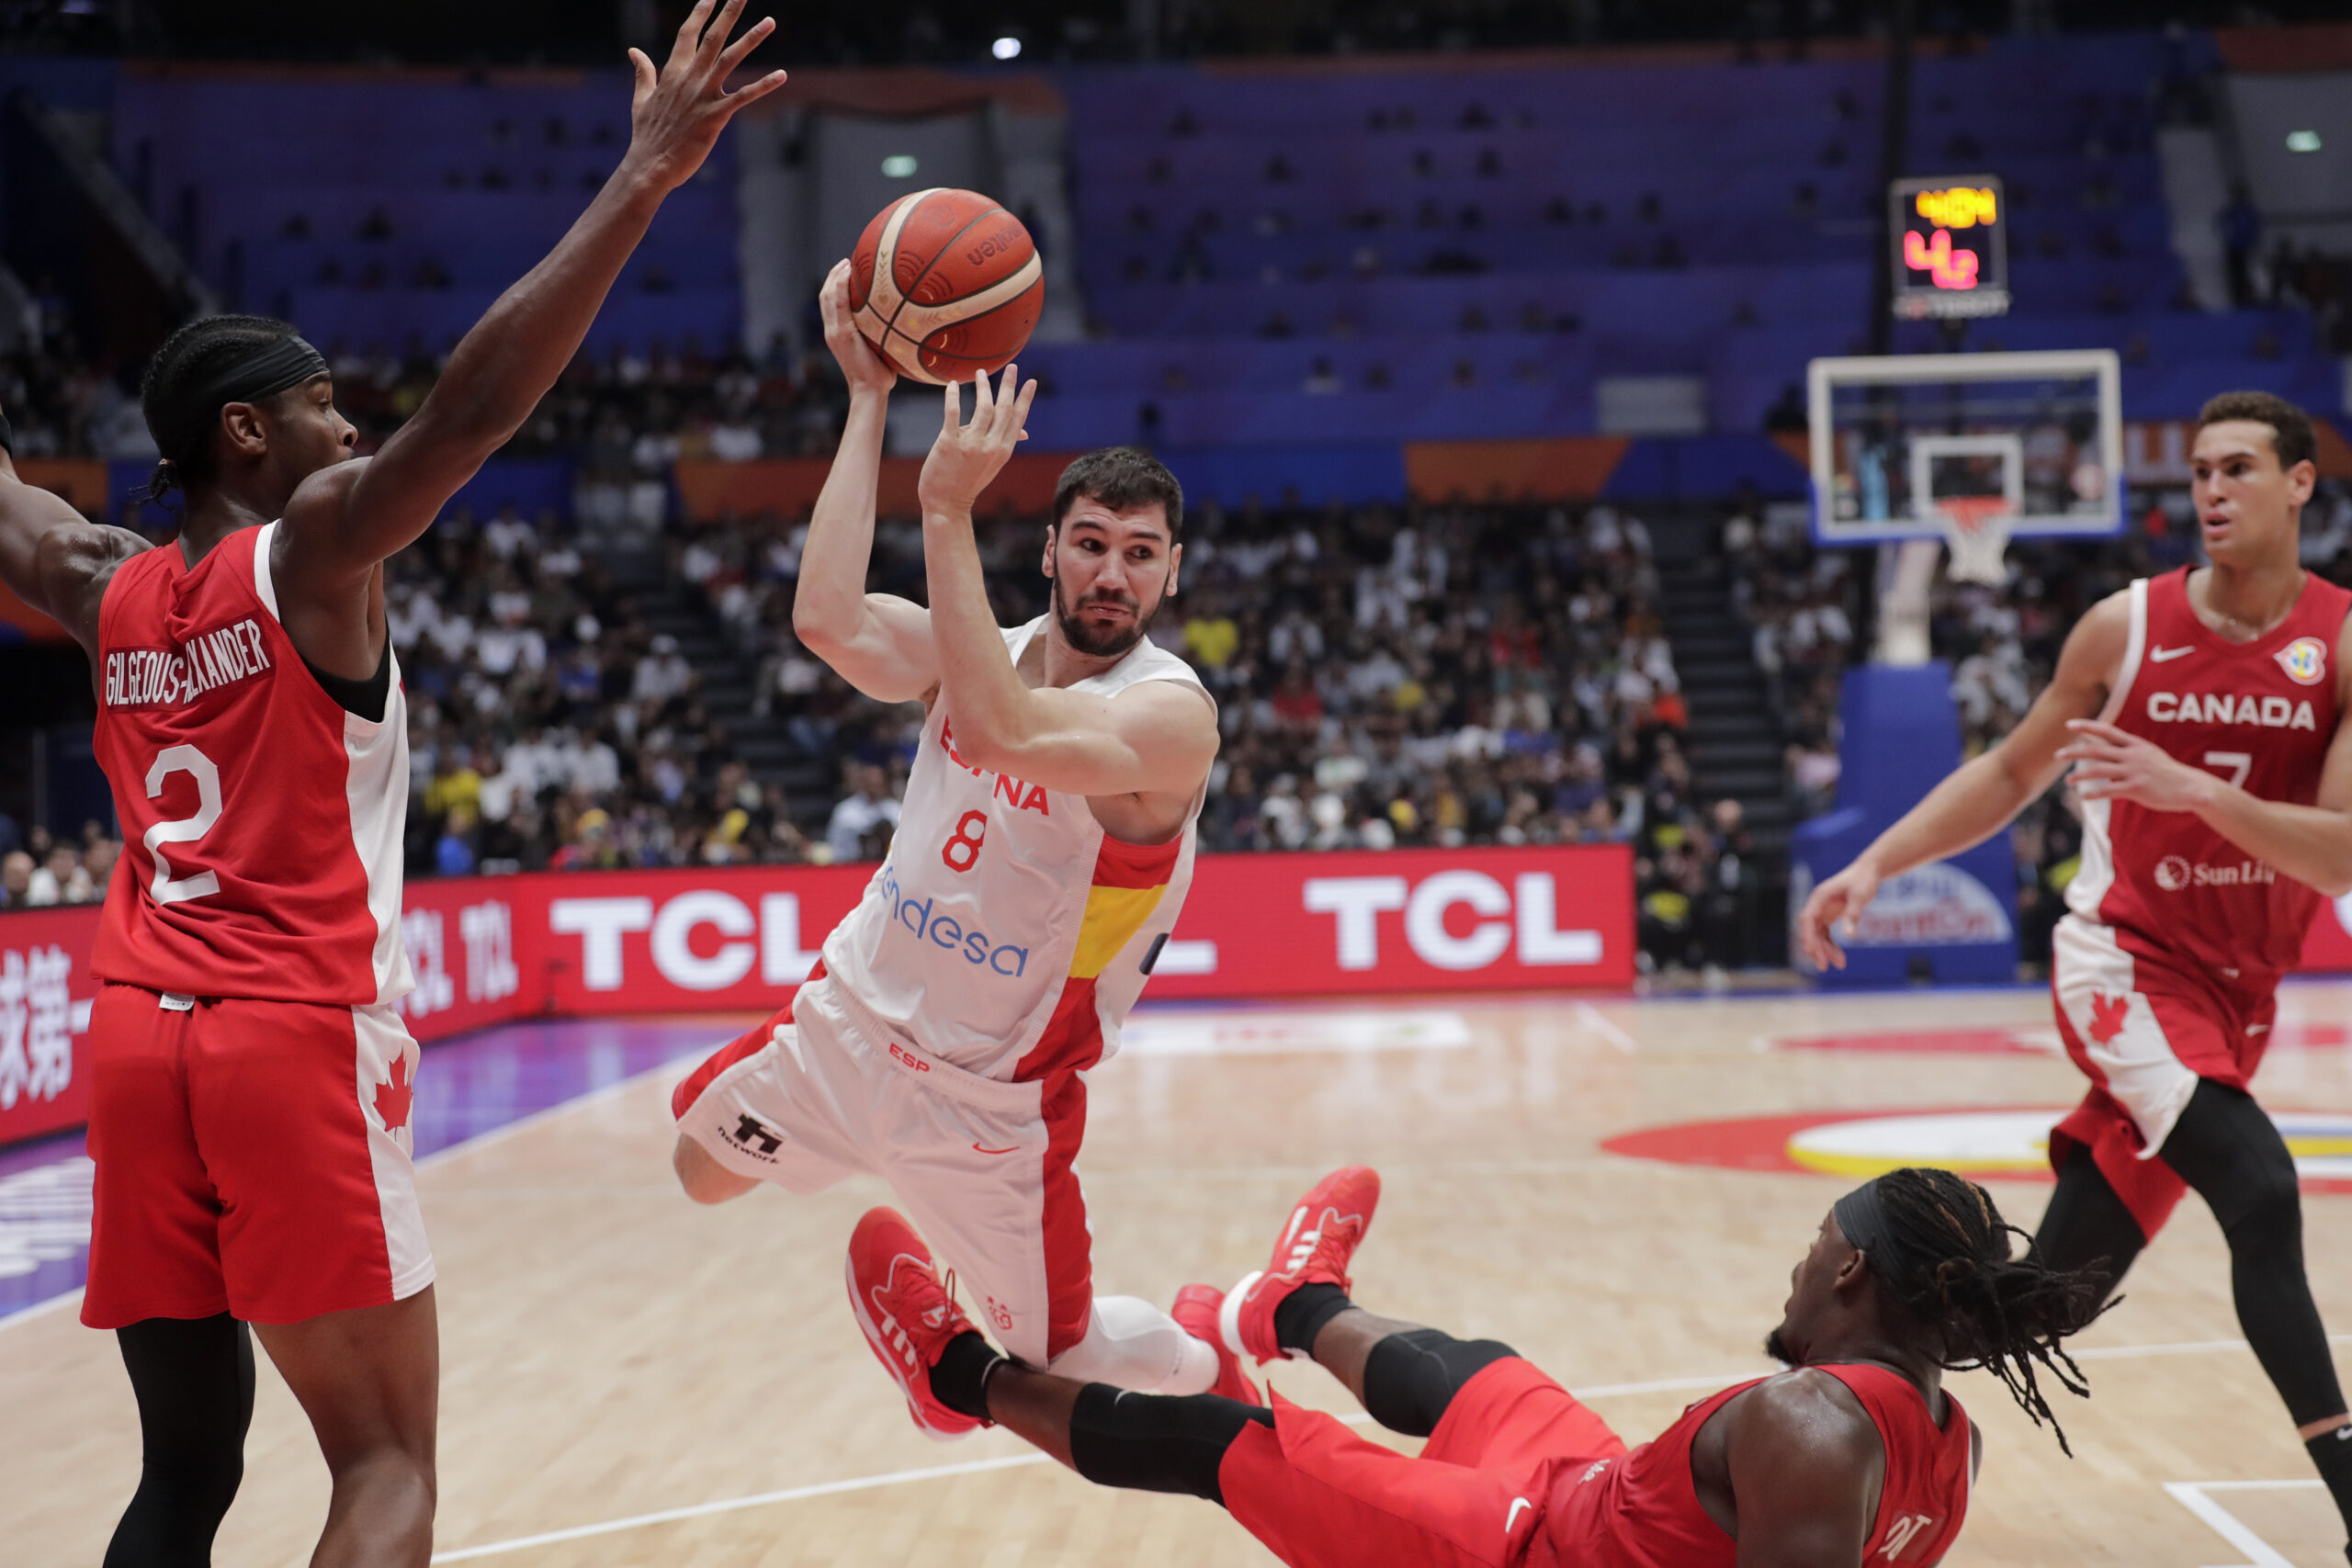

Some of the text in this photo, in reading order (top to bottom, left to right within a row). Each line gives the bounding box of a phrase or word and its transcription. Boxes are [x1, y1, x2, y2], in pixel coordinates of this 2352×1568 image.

[2147, 692, 2316, 731] CANADA
[2204, 750, 2252, 789] 7
[143, 744, 222, 906] 2
[942, 809, 988, 873] 8
[2192, 862, 2239, 886] Sun
[549, 888, 822, 991] TCL
[882, 865, 1029, 977] endesa
[1303, 869, 1602, 970] TCL
[889, 1043, 930, 1072] ESP
